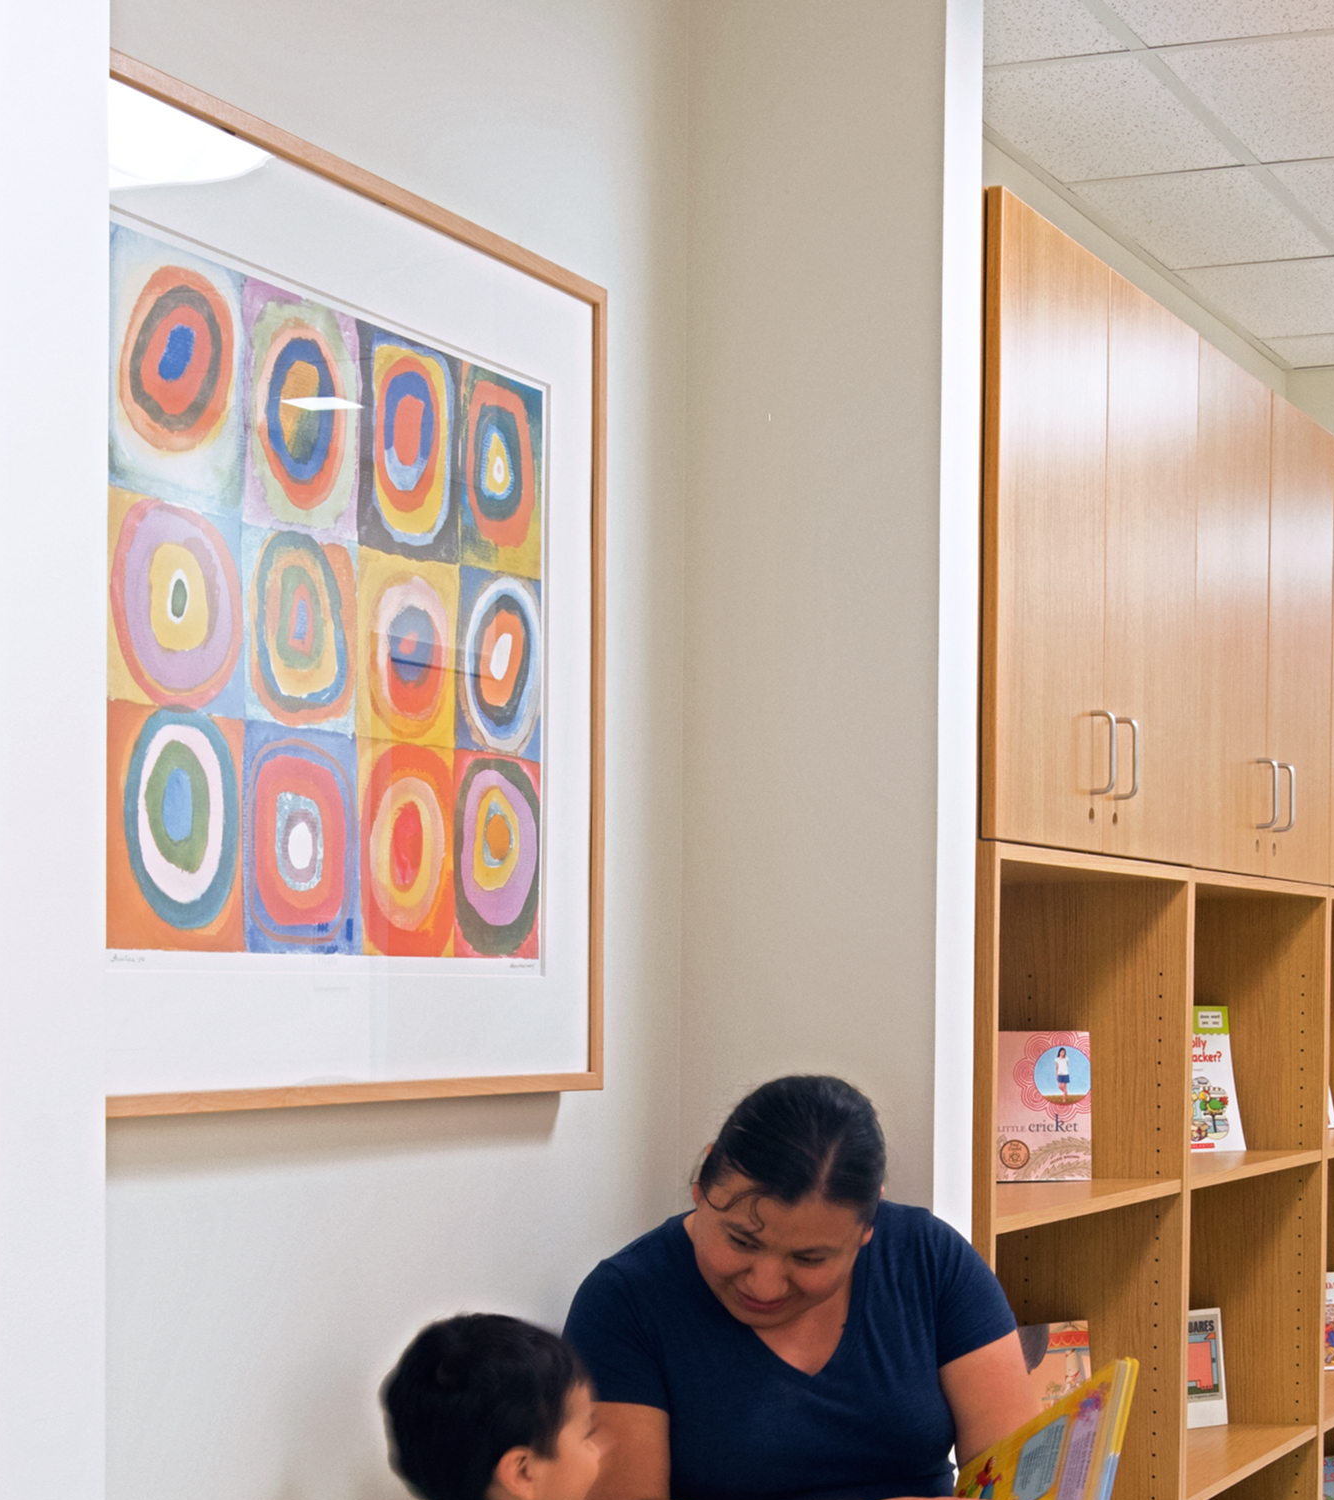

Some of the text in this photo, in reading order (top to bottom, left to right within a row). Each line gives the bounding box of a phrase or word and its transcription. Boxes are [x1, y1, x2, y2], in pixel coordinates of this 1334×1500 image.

[1192, 1037, 1207, 1050] olly
[1192, 1050, 1222, 1062] acker?
[1028, 1113, 1079, 1133] cricket
[1188, 1320, 1214, 1333] UARES
